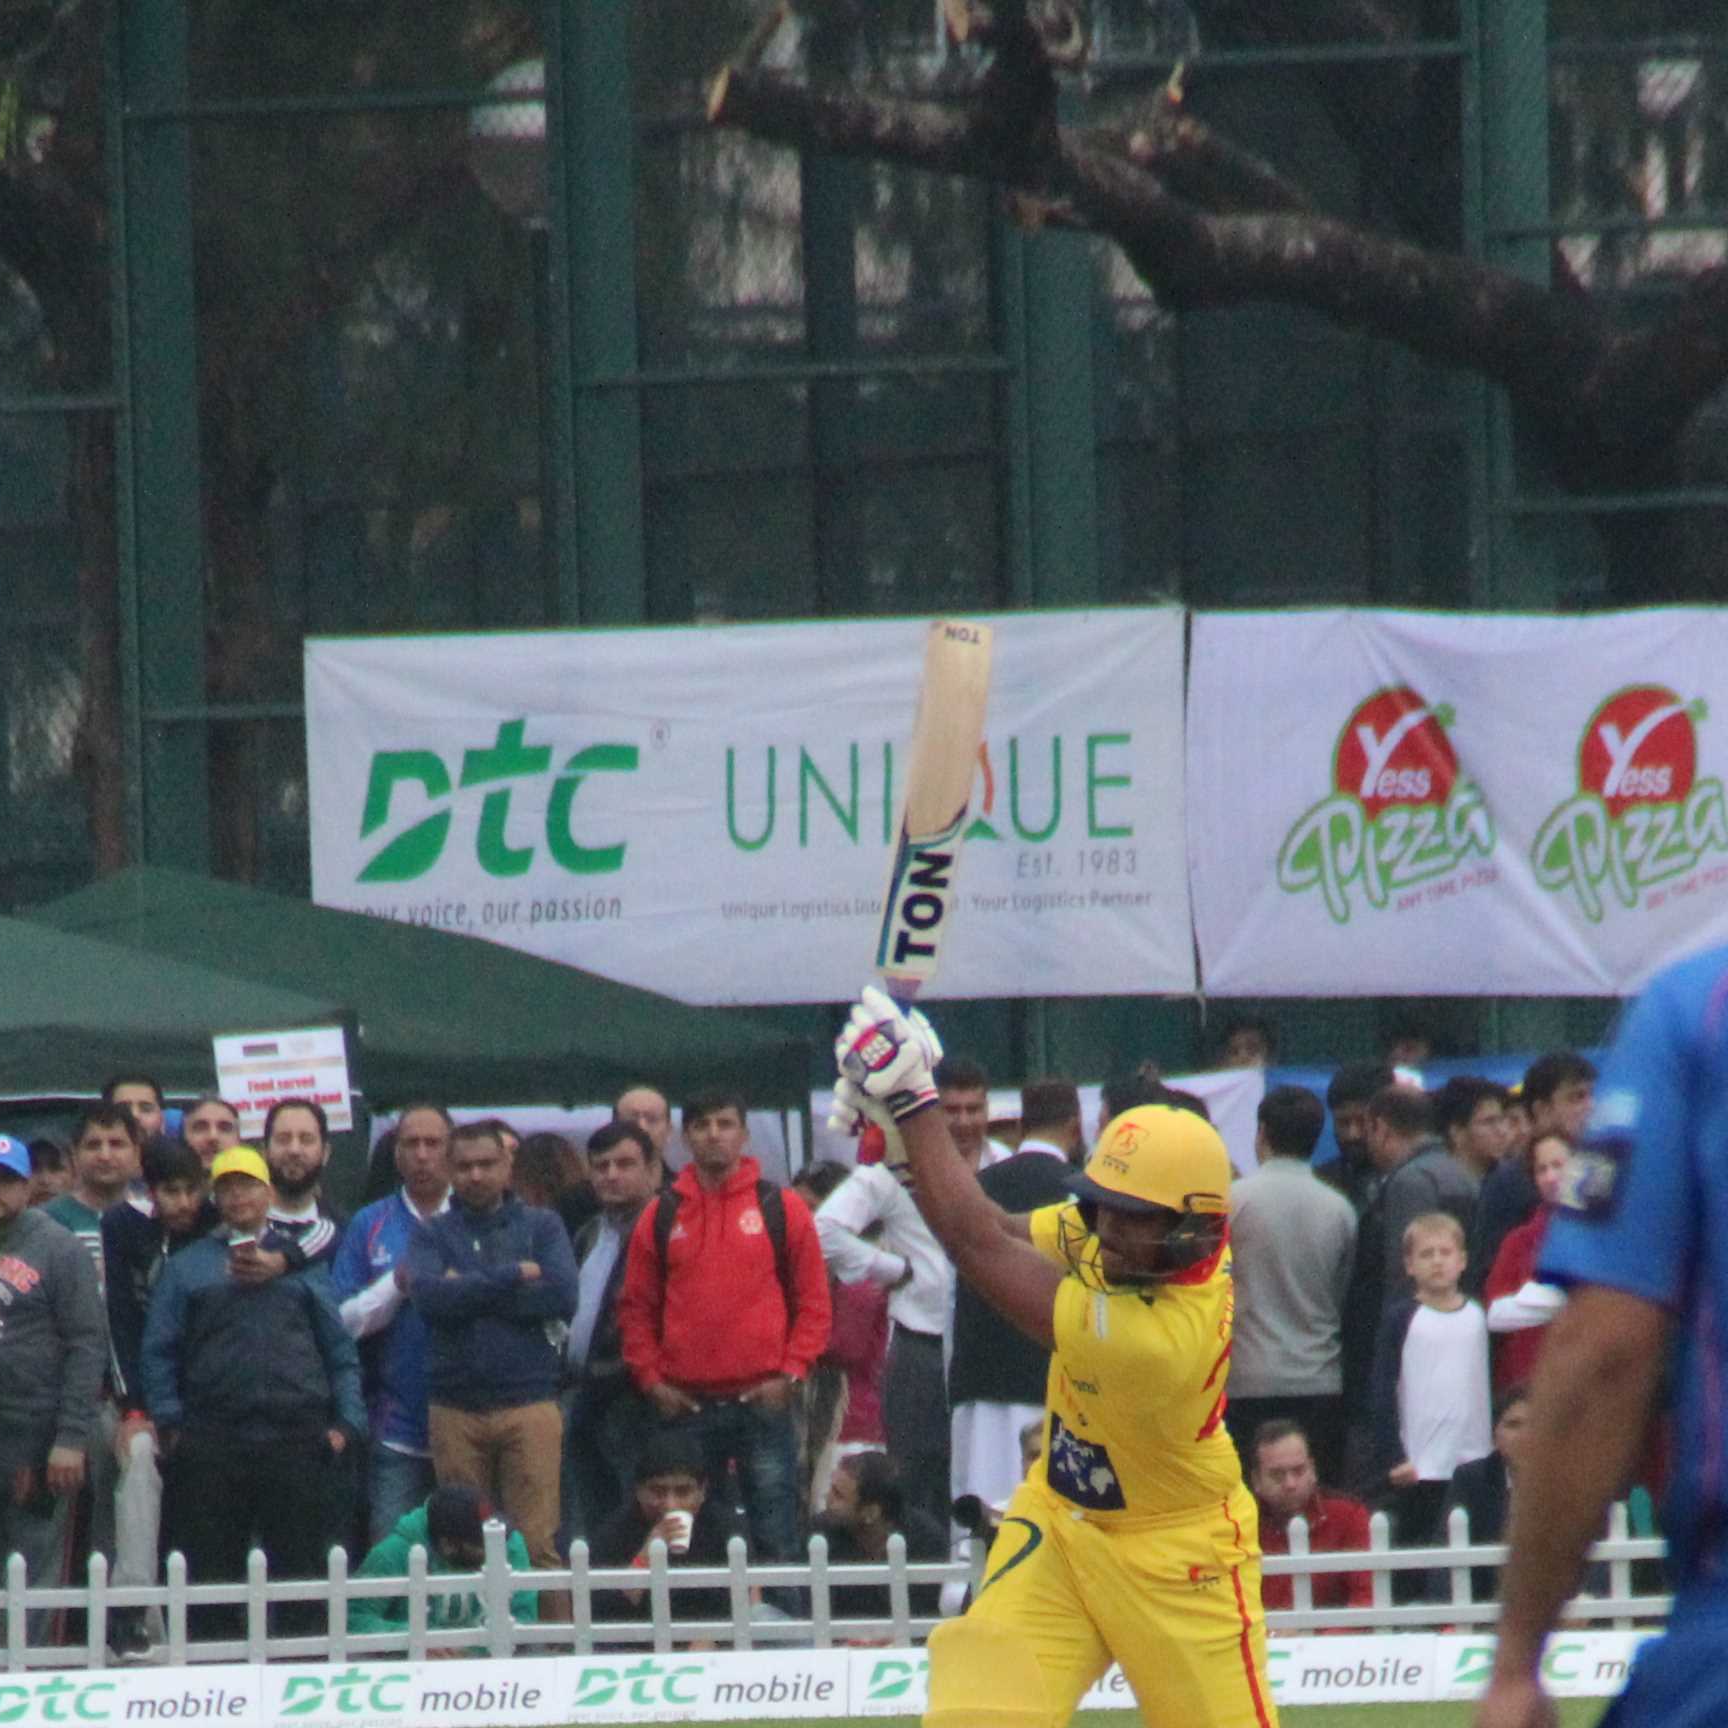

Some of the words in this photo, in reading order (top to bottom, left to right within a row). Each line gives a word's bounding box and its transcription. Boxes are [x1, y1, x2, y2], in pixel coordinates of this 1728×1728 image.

[945, 626, 981, 645] TON
[725, 731, 1134, 852] UNIUE
[1077, 848, 1138, 877] 1983
[1275, 782, 1496, 924] Pizza
[482, 900, 520, 925] our
[530, 893, 622, 926] passion
[893, 851, 954, 965] TON
[713, 1671, 835, 1703] mobile
[1300, 1656, 1422, 1689] mobile
[125, 1688, 247, 1721] mobile
[420, 1677, 543, 1712] mobile
